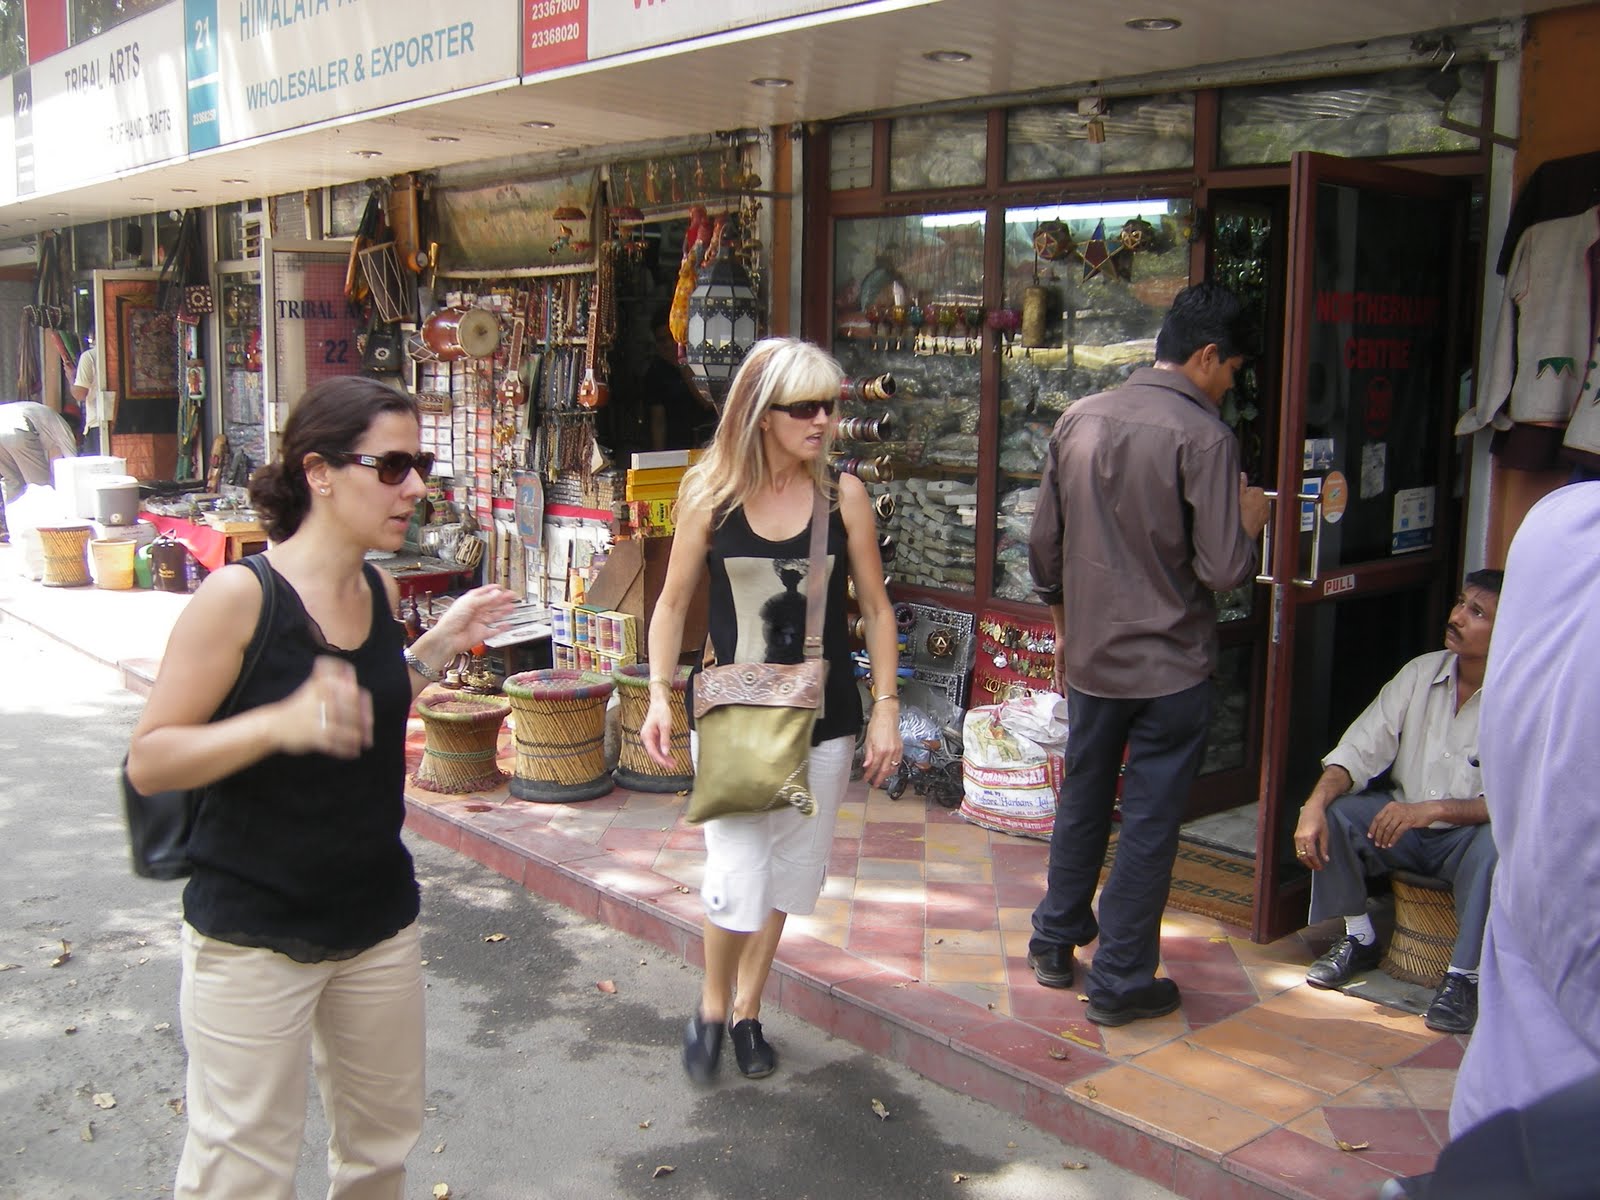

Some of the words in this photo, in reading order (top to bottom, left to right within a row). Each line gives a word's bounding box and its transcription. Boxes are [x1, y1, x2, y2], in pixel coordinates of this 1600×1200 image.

[195, 16, 211, 49] 21
[531, 22, 580, 48] 23368020
[65, 58, 104, 95] TRIBAL
[109, 42, 140, 85] ARTS
[246, 58, 349, 110] WHOLESALER
[354, 53, 365, 82] &
[371, 21, 475, 77] EXPORTER
[17, 92, 29, 118] 22
[277, 300, 336, 319] TRIBAL
[325, 339, 348, 364] 22
[1343, 336, 1411, 369] CENTRE
[1325, 578, 1353, 595] PULL
